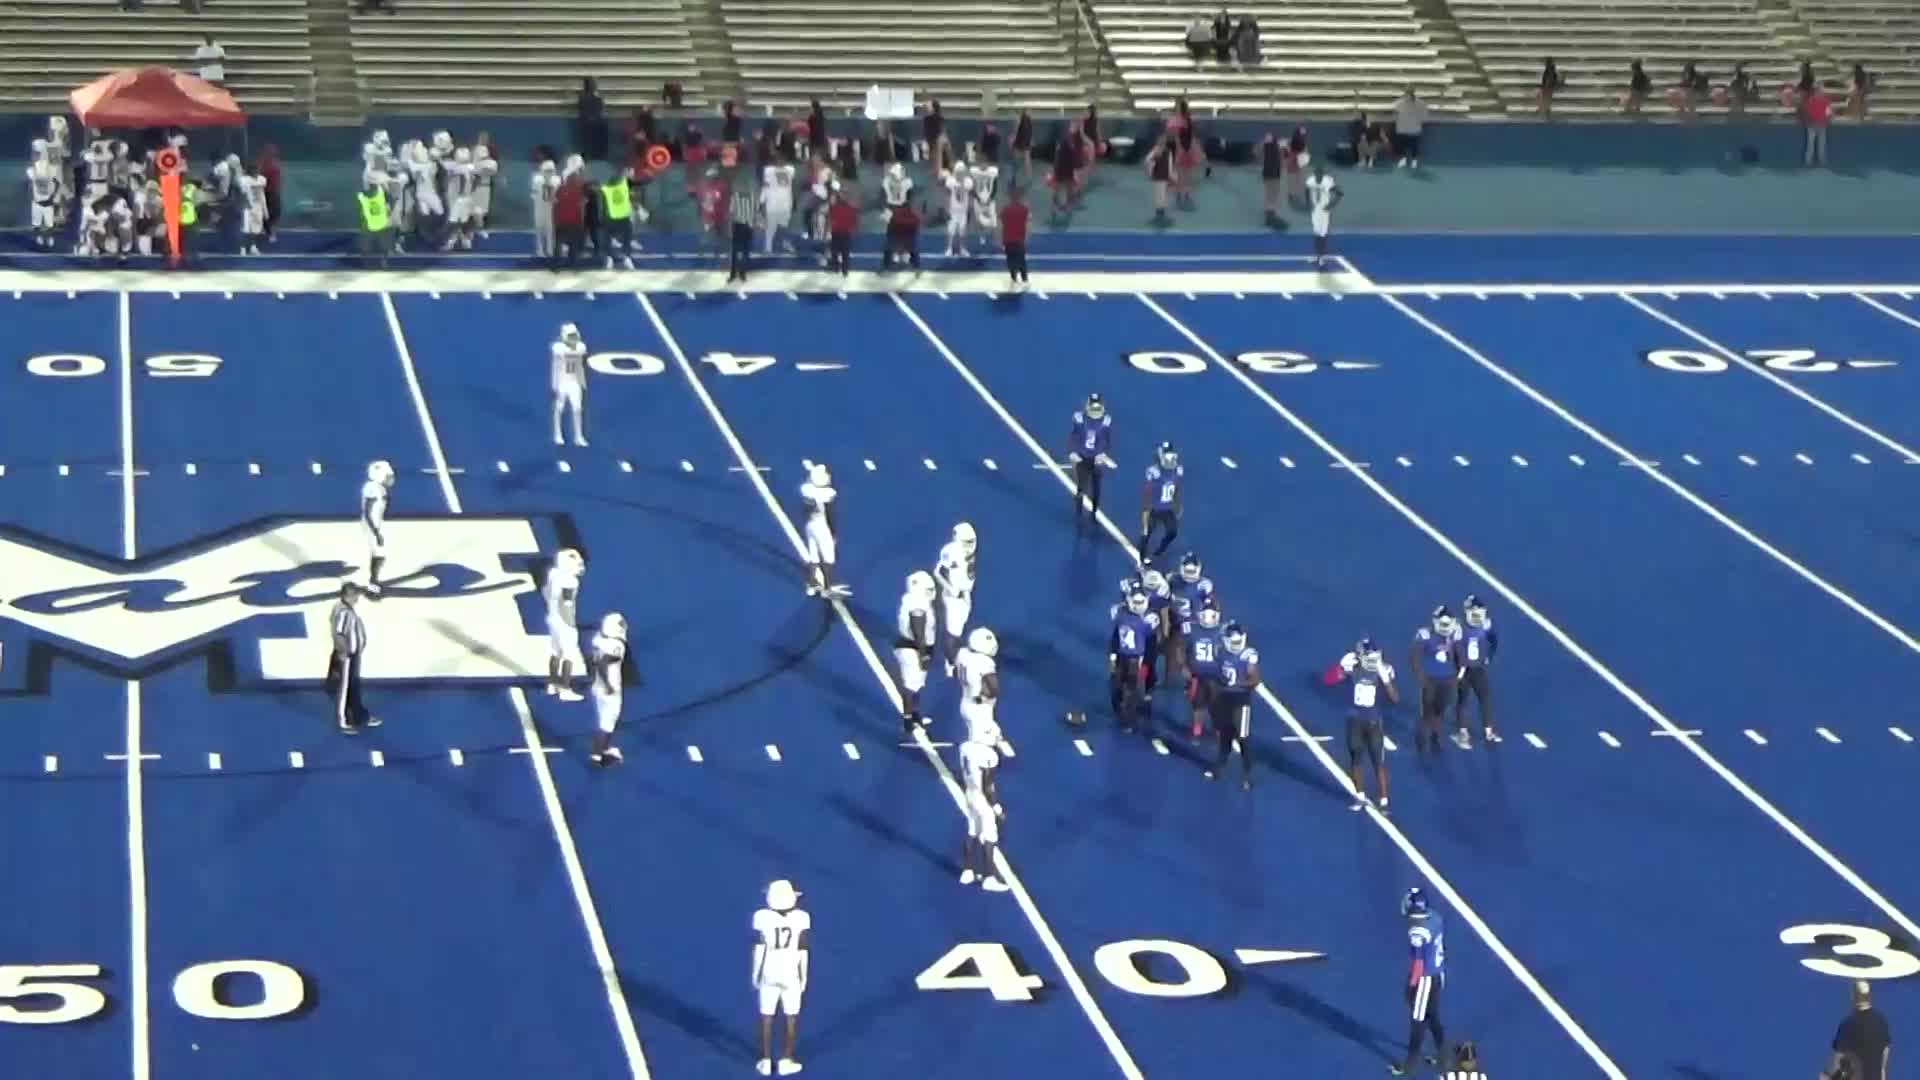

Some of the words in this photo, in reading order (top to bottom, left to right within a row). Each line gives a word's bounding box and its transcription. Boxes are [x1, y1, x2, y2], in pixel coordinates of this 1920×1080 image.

[1194, 641, 1213, 661] 51
[774, 926, 792, 949] 17
[916, 939, 1227, 1001] 40
